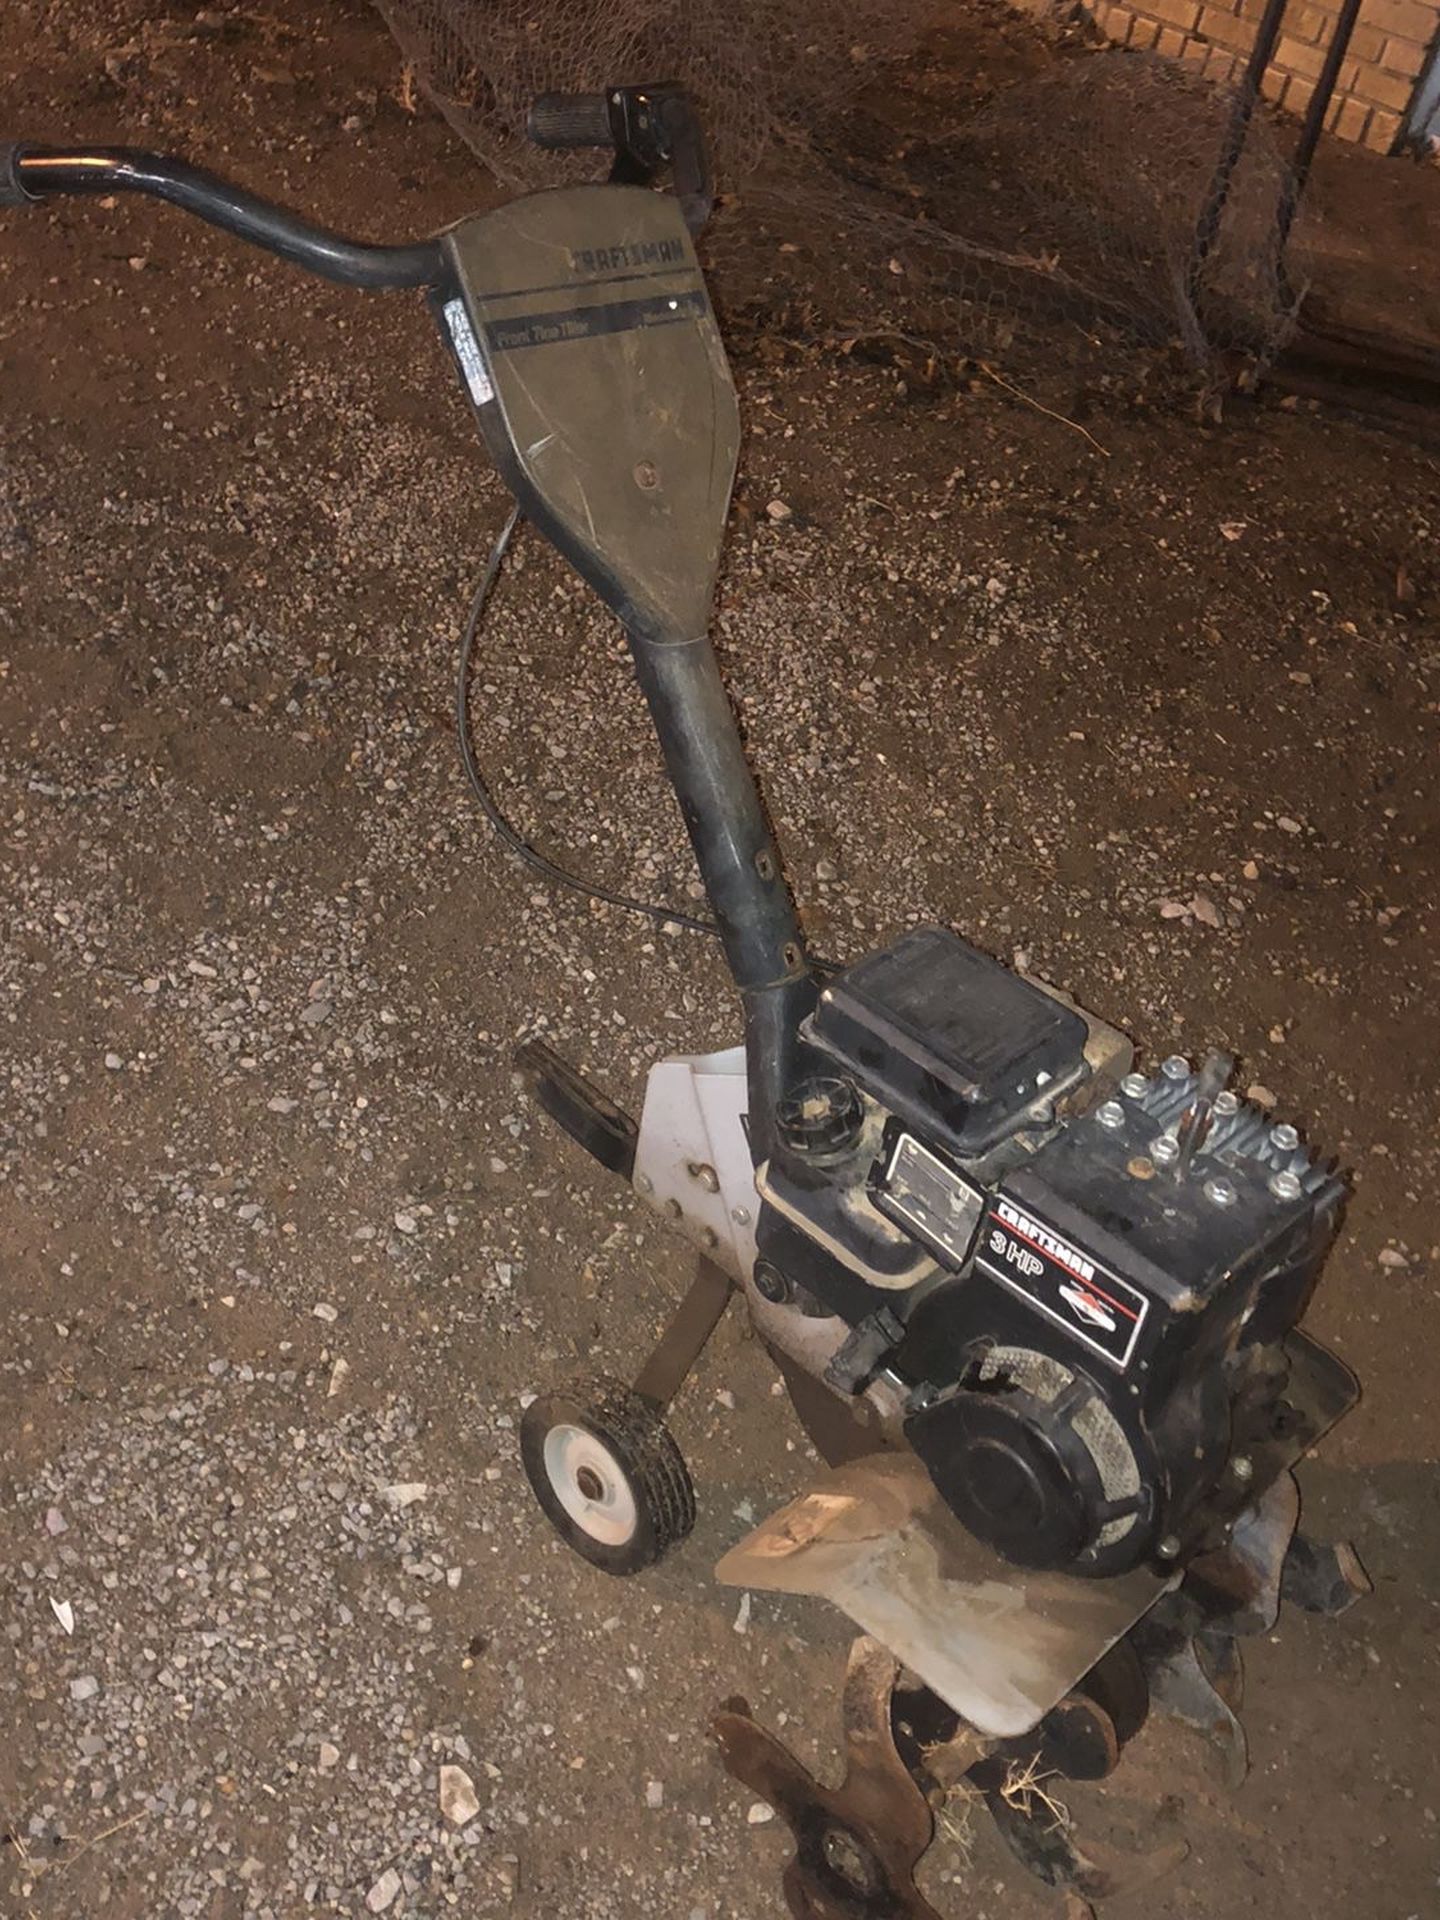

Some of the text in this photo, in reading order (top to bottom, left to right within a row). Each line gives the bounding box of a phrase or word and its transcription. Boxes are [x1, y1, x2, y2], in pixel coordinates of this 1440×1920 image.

[990, 1231, 1044, 1276] 3 HP
[998, 1203, 1095, 1281] CRAFTSMAN
